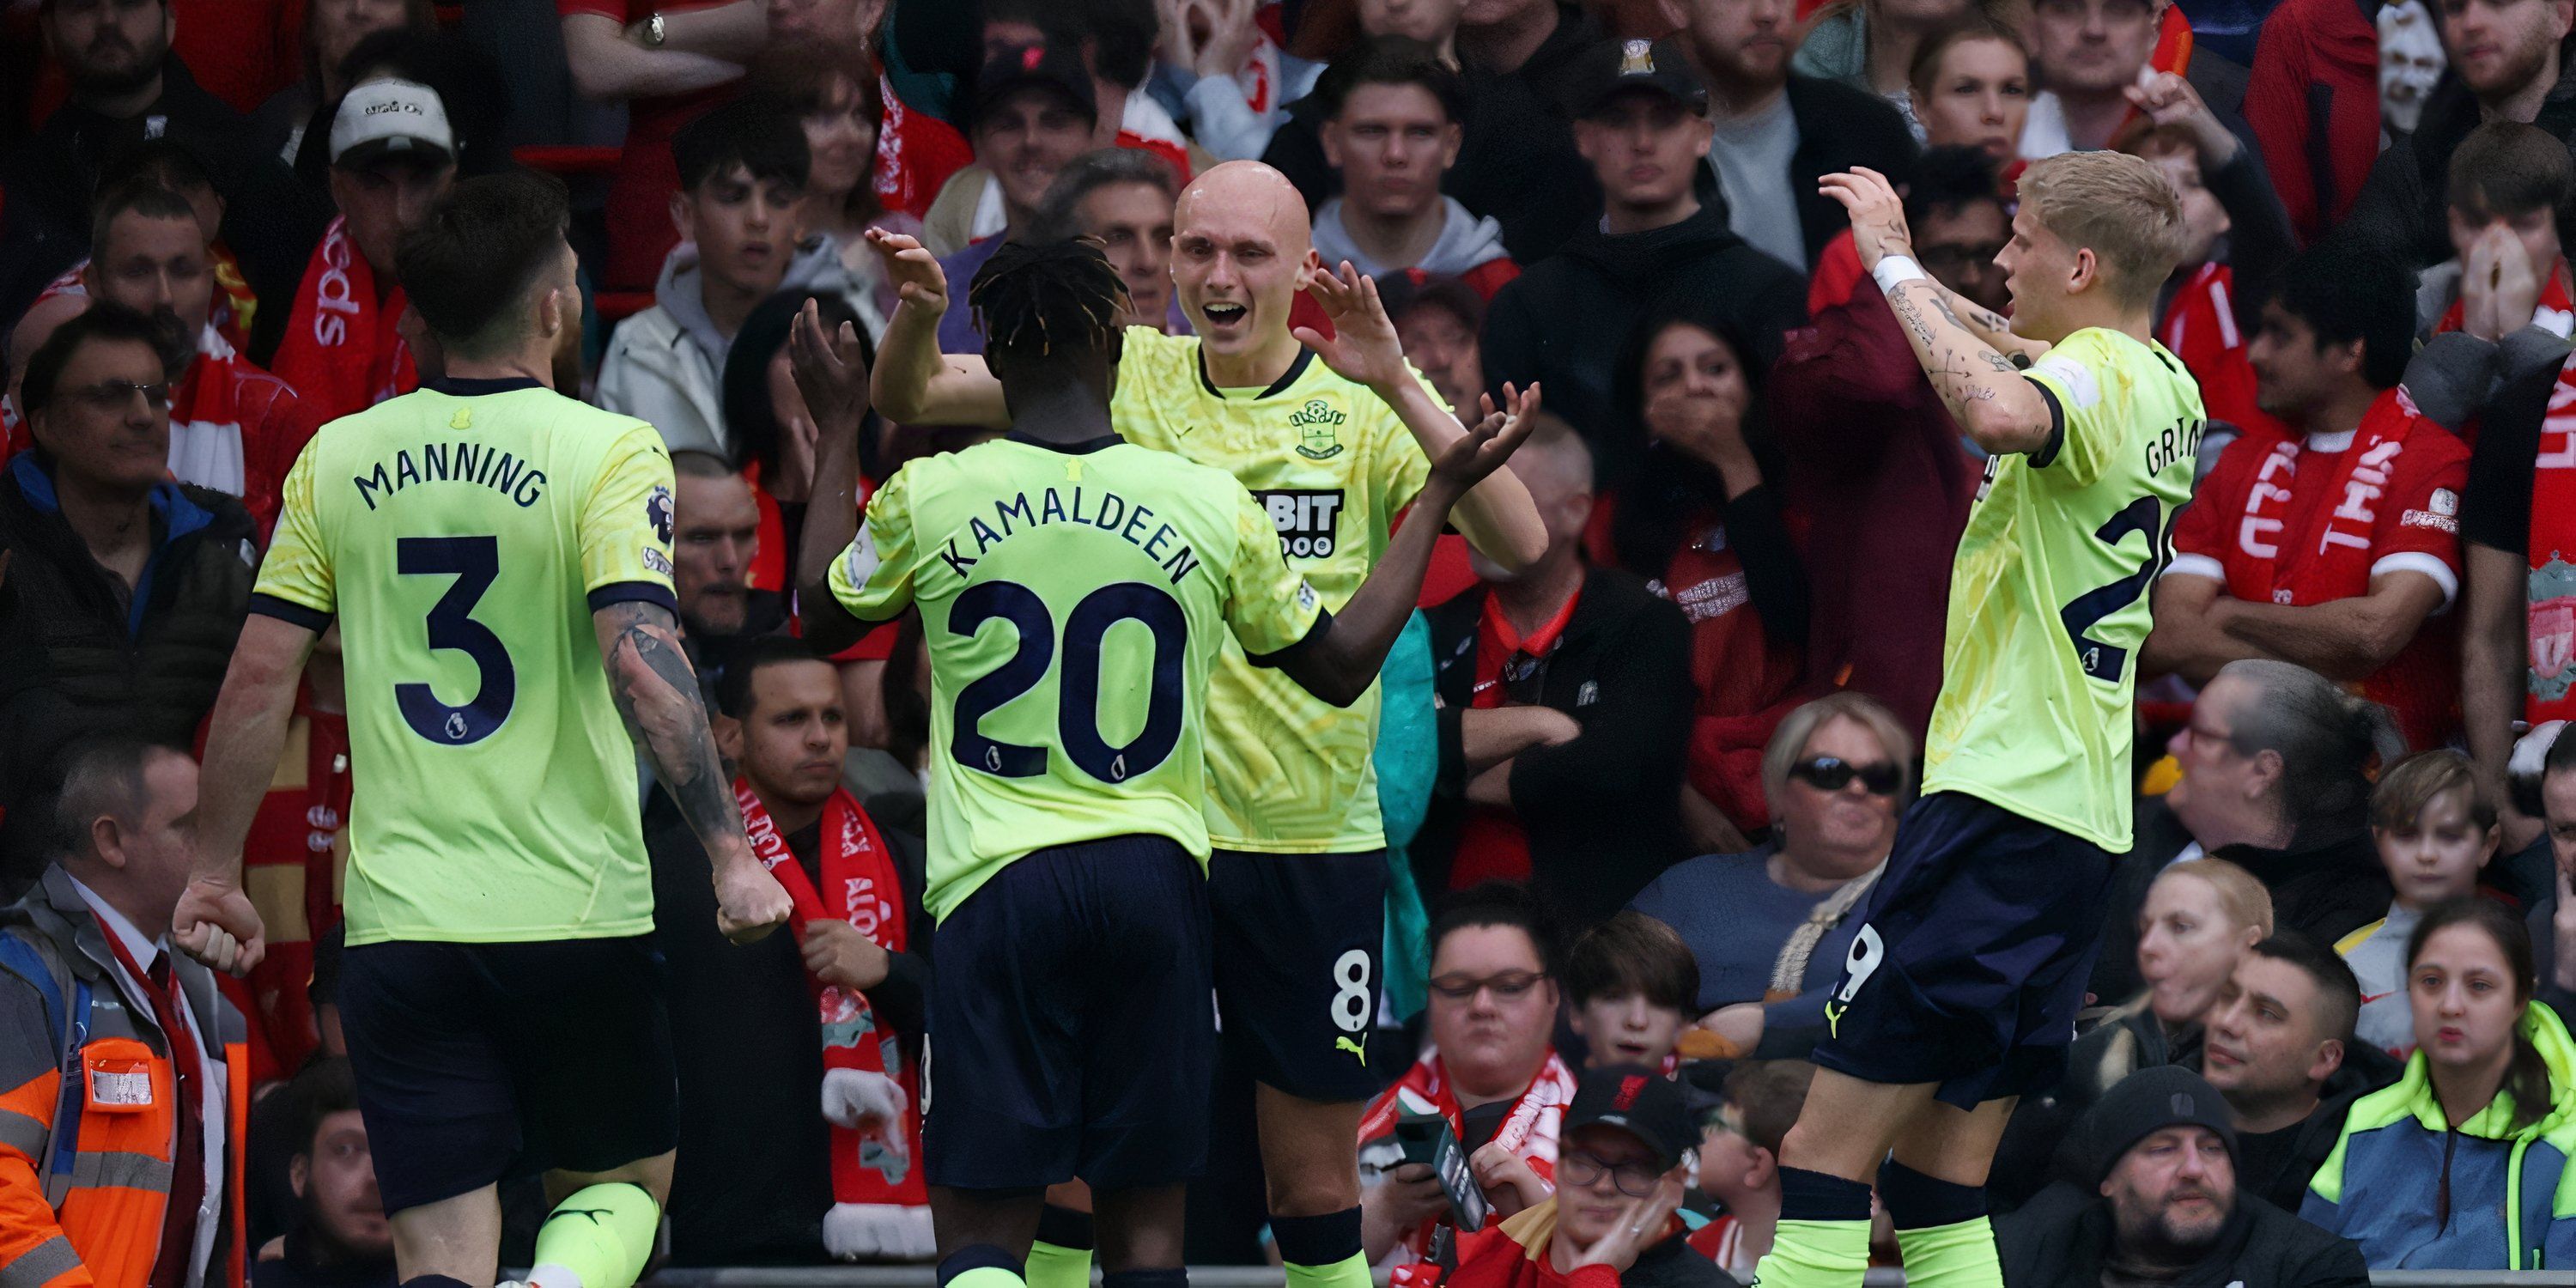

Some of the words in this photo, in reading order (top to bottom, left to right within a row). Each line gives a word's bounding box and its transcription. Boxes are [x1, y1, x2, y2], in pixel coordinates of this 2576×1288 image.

[353, 442, 547, 512] MANNING
[942, 486, 1200, 586] KAMALDEEN
[395, 536, 515, 745] 3
[948, 580, 1188, 784] 20
[1331, 949, 1371, 1032] 8
